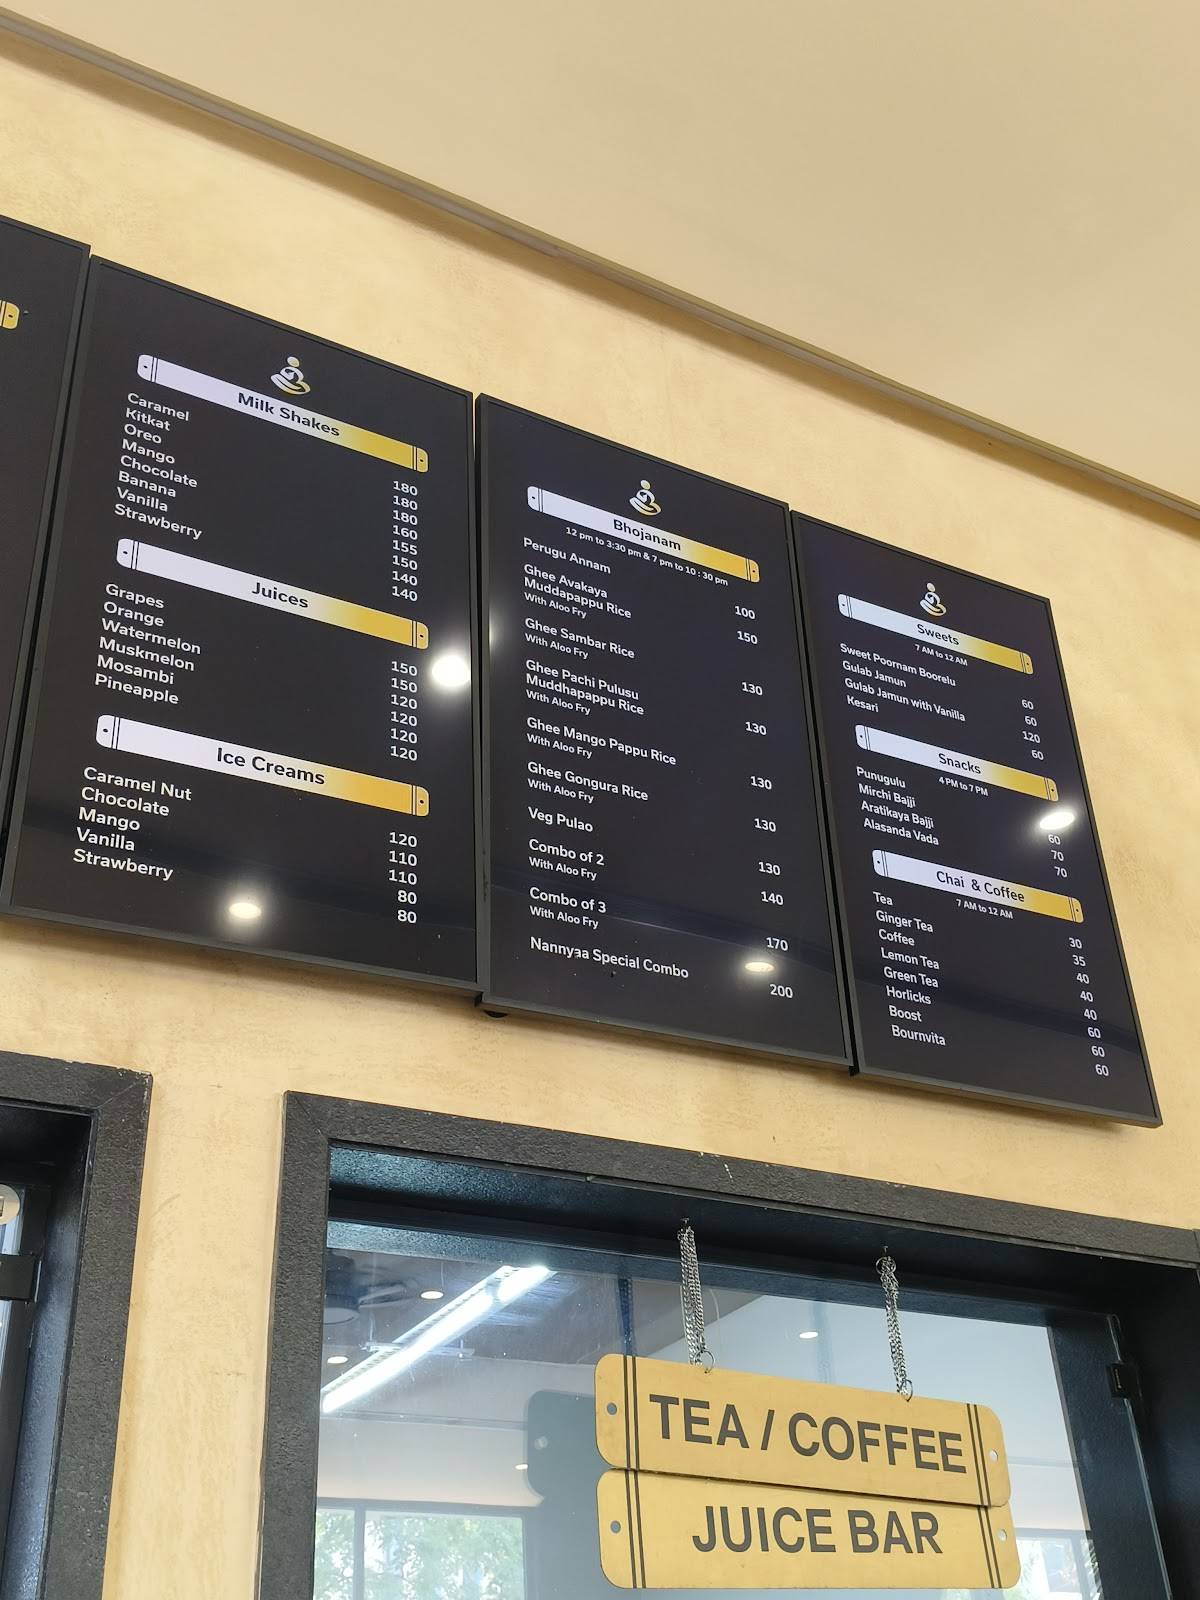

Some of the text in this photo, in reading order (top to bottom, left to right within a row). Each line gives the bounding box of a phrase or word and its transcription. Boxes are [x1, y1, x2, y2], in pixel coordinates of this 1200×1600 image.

[128, 393, 189, 421] Caramel
[239, 393, 339, 436] Milk Shakes
[126, 408, 170, 431] Kitkat
[124, 424, 162, 444] Oreo
[122, 439, 175, 464] Mango
[121, 455, 197, 488] Chocolate
[119, 470, 176, 497] Banana
[394, 481, 418, 496] 180
[117, 487, 168, 512] Vanilla
[393, 496, 418, 510] 180
[115, 504, 202, 540] Strawberry
[393, 510, 418, 525] 180
[393, 525, 418, 540] 160
[614, 520, 681, 550] Bhojanam
[393, 540, 418, 555] 155
[524, 537, 611, 574] Perugu Annam
[566, 527, 577, 537] 12
[580, 533, 593, 542] pm
[596, 537, 605, 545] to
[607, 540, 626, 552] 3:30
[628, 549, 642, 558] pm
[660, 559, 673, 568] pm
[675, 563, 684, 571] to
[686, 566, 696, 575] 10
[702, 572, 713, 581] 30
[715, 577, 728, 586] pm
[393, 555, 418, 570] 150
[392, 571, 418, 586] 140
[524, 564, 607, 598] Ghee Avakaya
[106, 584, 164, 608] Grapes
[252, 582, 308, 608] Juices
[392, 586, 418, 601] 140
[525, 576, 631, 618] Muddapappu Rice
[104, 602, 164, 627] Orange
[735, 606, 755, 619] 100
[102, 618, 200, 654] Watermelon
[525, 618, 635, 658] Ghee Sambar Rice
[737, 631, 758, 644] 150
[917, 624, 959, 645] Sweets
[100, 636, 194, 671] Muskmelon
[840, 643, 956, 686] Sweet Poornam Boorelu
[98, 654, 174, 684] Mosambi
[392, 661, 418, 676] 150
[843, 660, 906, 687] Gulab Jamun
[95, 673, 179, 704] Pineapple
[392, 678, 418, 693] 150
[526, 660, 639, 700] Ghee Pachi Pulusu
[742, 682, 763, 696] 130
[391, 694, 417, 709] 120
[526, 673, 644, 715] Muddhapappu Rice
[845, 678, 966, 721] Gulab Jamun with Vanilla
[847, 695, 879, 713] Kesari
[391, 712, 417, 727] 120
[746, 722, 767, 735] 130
[391, 728, 417, 744] 120
[527, 717, 676, 765] Ghee Mango Pappu Rice
[1022, 731, 1040, 743] 120
[391, 746, 417, 761] 120
[939, 753, 981, 774] Snacks
[218, 748, 324, 784] Ice Creams
[856, 766, 906, 788] Punugulu
[84, 767, 192, 801] Caramel Nut
[528, 762, 648, 800] Ghee Gongura Rice
[751, 776, 772, 790] 130
[82, 787, 169, 816] Chocolate
[859, 783, 916, 808] Mirchi Bajji
[79, 807, 140, 831] Mango
[528, 806, 593, 832] Veg Pulao
[754, 818, 776, 832] 130
[862, 800, 934, 829] Aratikaya Bajji
[77, 827, 135, 851] Vanilla
[390, 832, 417, 847] 120
[864, 818, 939, 845] Alasanda Vada
[1048, 834, 1061, 845] 60
[389, 851, 417, 866] 110
[529, 839, 604, 866] Combo of 2
[1051, 850, 1064, 861] 70
[73, 849, 173, 881] Strawberry
[529, 856, 597, 881] With Aloo Fry
[759, 862, 781, 875] 130
[1054, 866, 1067, 878] 70
[389, 870, 417, 885] 110
[937, 871, 964, 888] Chai
[984, 883, 1024, 902] Coffee
[398, 890, 417, 904] 80
[530, 887, 606, 913] Combo of 3
[761, 891, 783, 905] 140
[873, 892, 893, 905] Tea
[398, 910, 417, 923] 80
[876, 910, 933, 933] Ginger Tea
[766, 937, 788, 951] 170
[879, 929, 915, 946] Coffee
[1069, 938, 1082, 949] 30
[531, 936, 689, 978] Nannyaa Special Combo
[881, 947, 940, 970] Lemon Tea
[1072, 955, 1086, 966] 35
[884, 966, 938, 988] Green Tea
[1077, 973, 1090, 984] 40
[770, 984, 793, 998] 200
[886, 985, 931, 1005] Horlicks
[1080, 991, 1093, 1002] 40
[889, 1005, 922, 1022] Boost
[1084, 1009, 1097, 1020] 40
[892, 1024, 946, 1046] Bournvita
[650, 1394, 967, 1474] TEA / COFFEE
[692, 1506, 943, 1554] JUICE BAR
